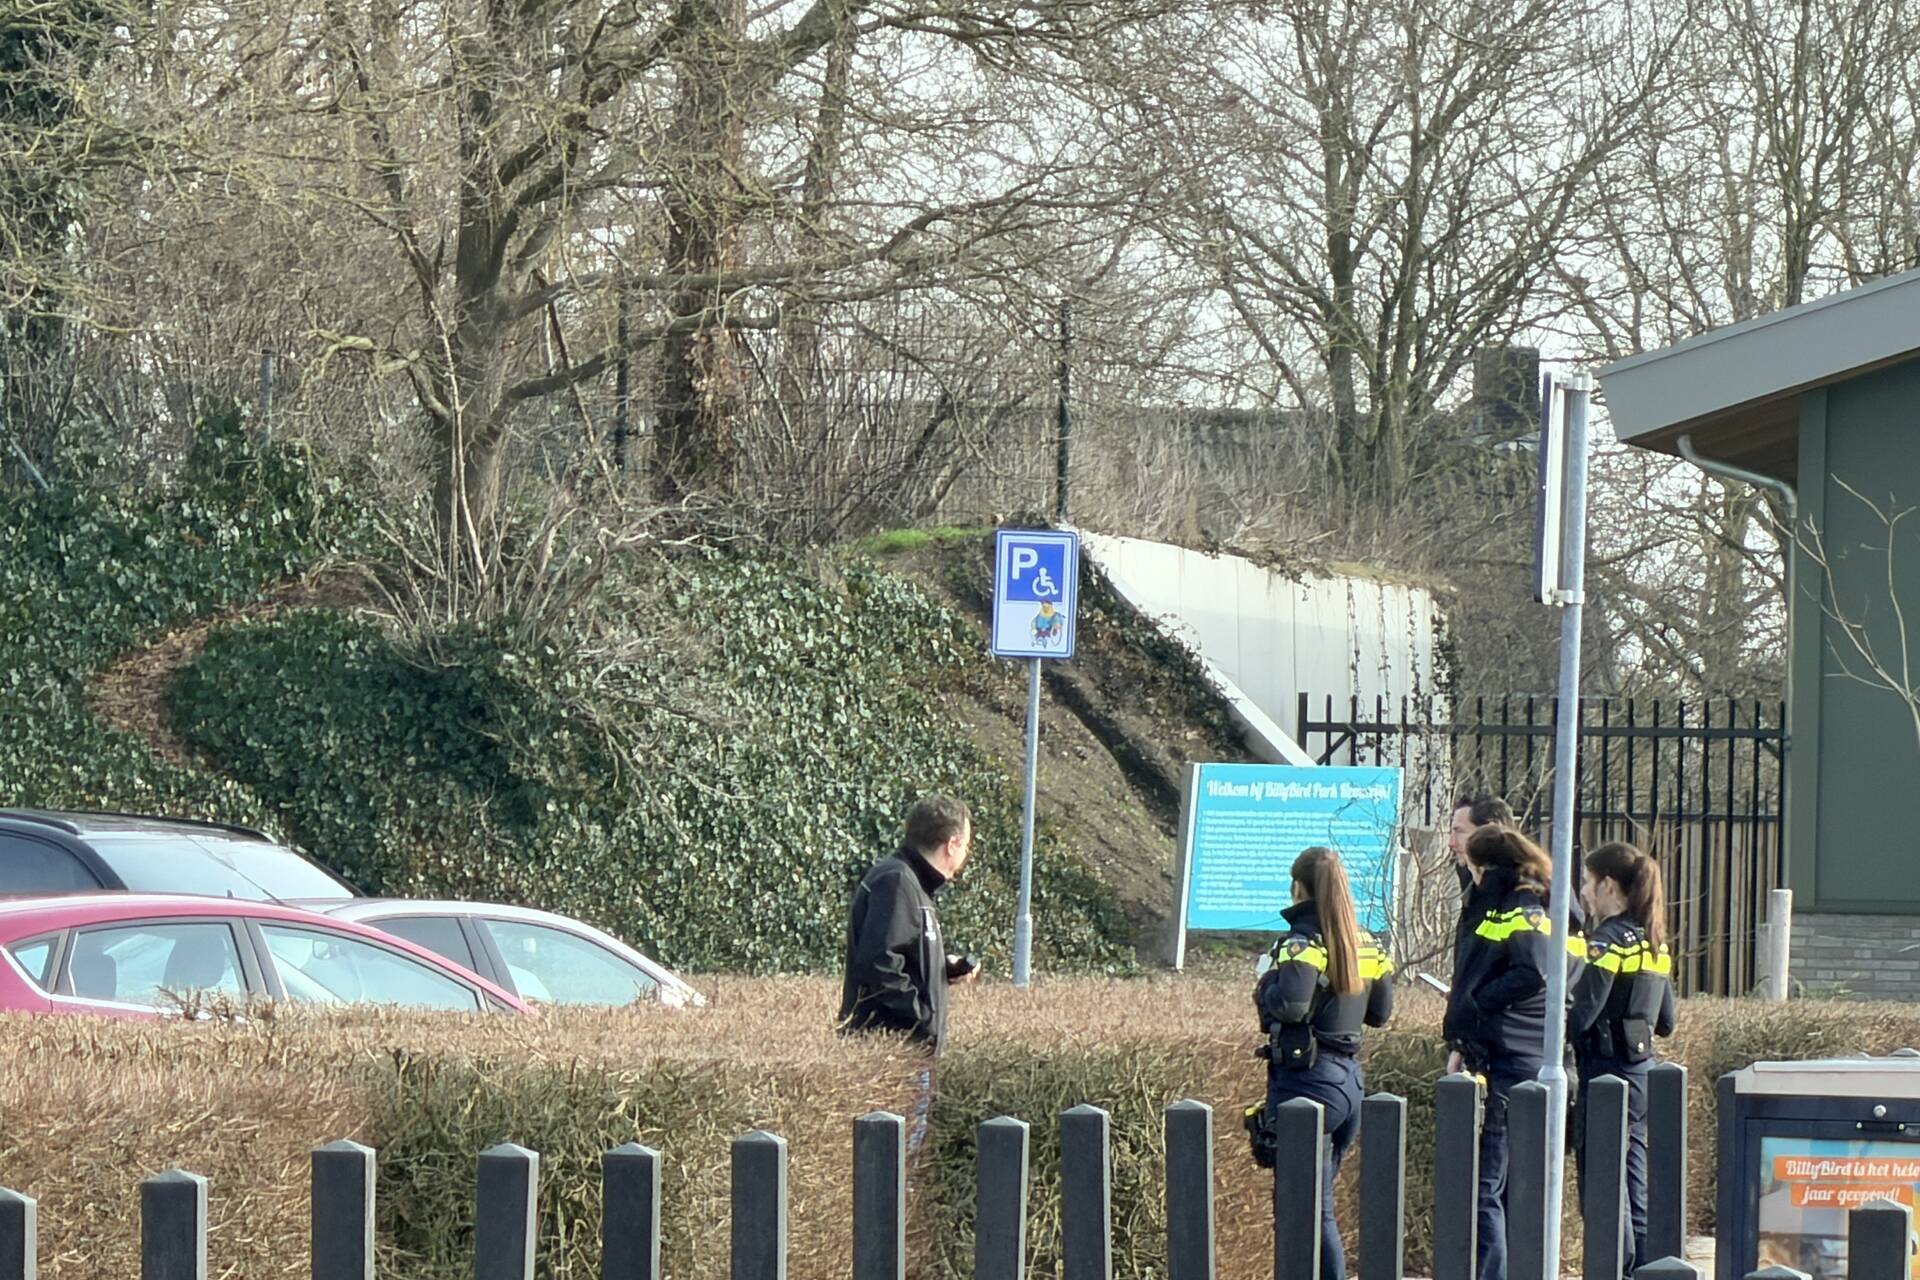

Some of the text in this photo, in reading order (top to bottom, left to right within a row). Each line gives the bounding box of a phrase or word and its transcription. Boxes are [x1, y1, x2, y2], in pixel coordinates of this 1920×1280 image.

[1011, 547, 1039, 580] P
[1785, 1160, 1920, 1180] BillyBird is het hele
[1801, 1186, 1900, 1205] jaar geopend!
